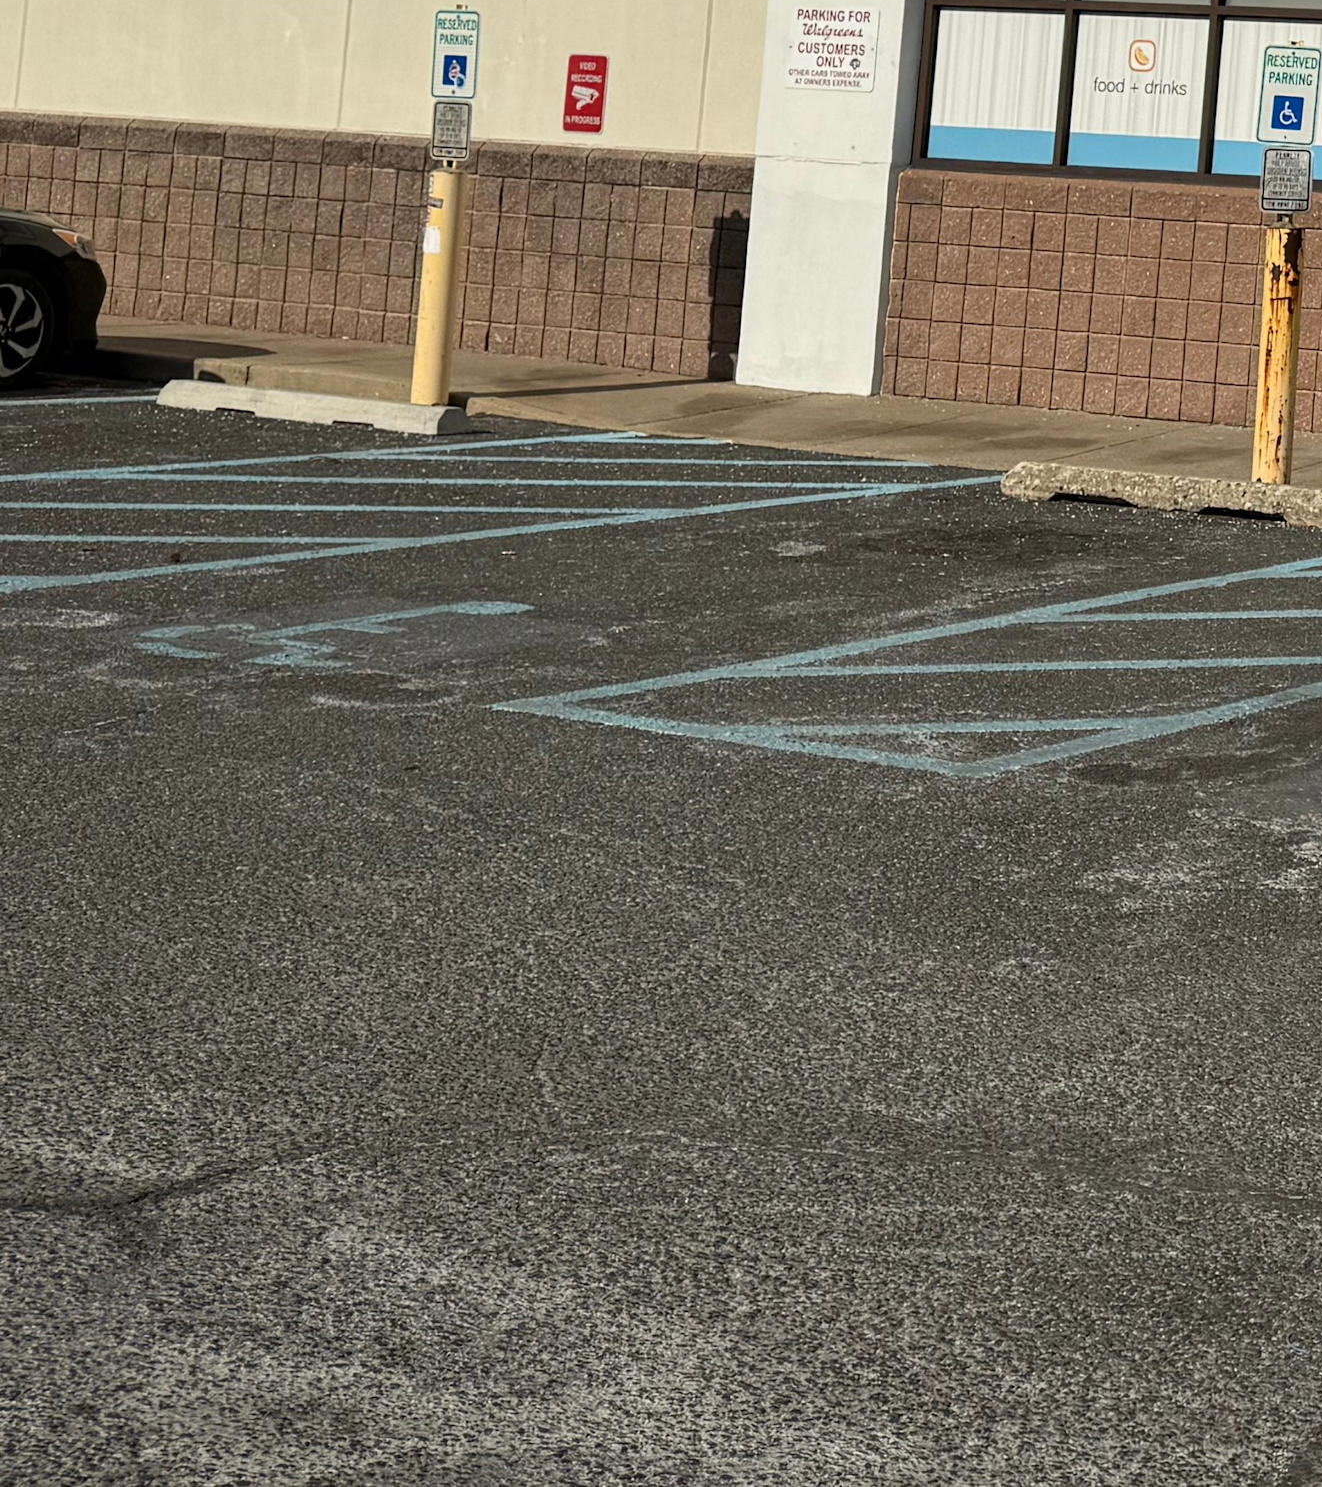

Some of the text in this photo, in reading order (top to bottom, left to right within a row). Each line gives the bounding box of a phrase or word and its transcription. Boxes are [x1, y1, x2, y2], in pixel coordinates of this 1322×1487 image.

[797, 9, 871, 23] PARKING FOR
[437, 18, 477, 30] RESERVED
[803, 23, 863, 40] Walgreens
[439, 34, 473, 45] PARKING
[798, 42, 866, 56] CUSTOMERS
[816, 56, 845, 67] ONLY
[1267, 54, 1317, 69] RESERVED
[1094, 77, 1187, 95] food + drinks
[1269, 72, 1313, 86] PARKING
